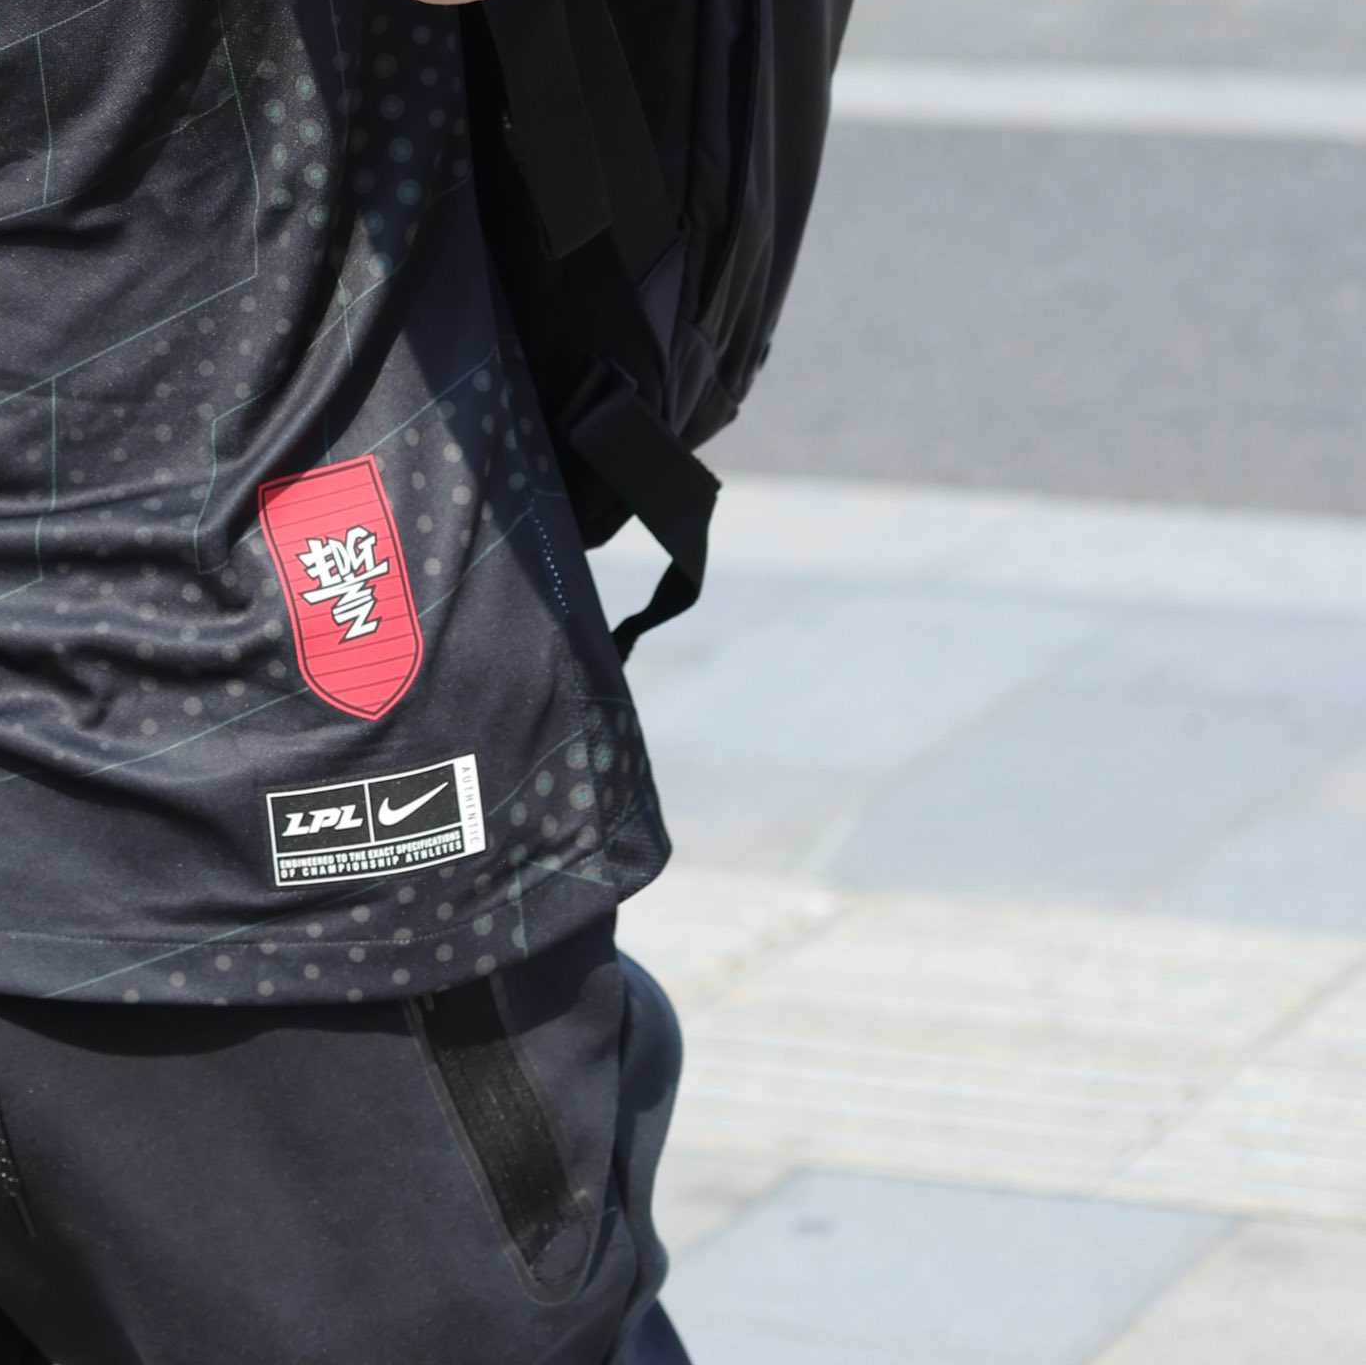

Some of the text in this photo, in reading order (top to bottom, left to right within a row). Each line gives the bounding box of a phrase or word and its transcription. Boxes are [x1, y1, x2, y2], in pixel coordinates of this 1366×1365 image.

[281, 804, 364, 837] LPL
[461, 766, 480, 845] AUTHENTIC
[279, 830, 461, 870] ENGINEERED TO THE EXACT SPECIFICATIONS
[280, 839, 462, 879] OF CHAMPIONSHIP ATHLETES
